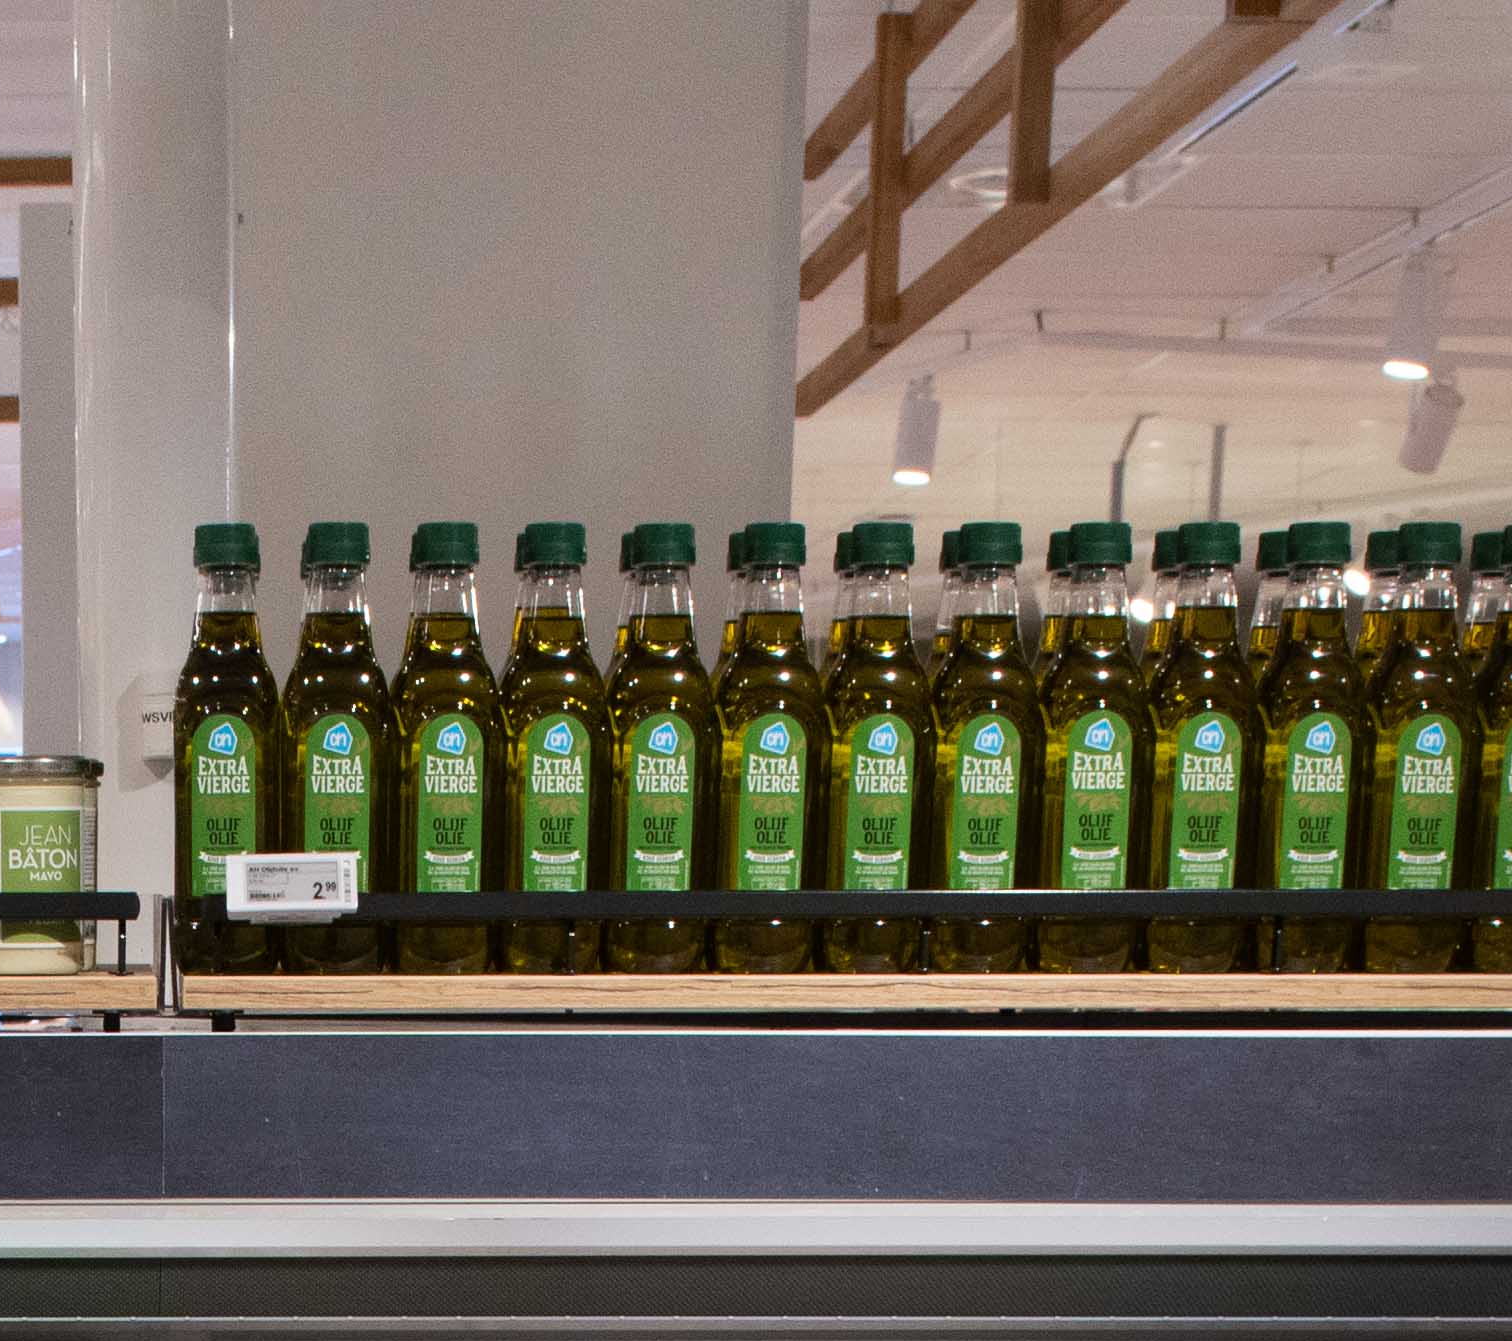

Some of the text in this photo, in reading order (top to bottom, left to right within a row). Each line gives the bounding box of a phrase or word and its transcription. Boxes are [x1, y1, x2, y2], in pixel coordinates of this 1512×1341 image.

[198, 756, 248, 776] EXTRA
[1399, 755, 1452, 775] EXTRA
[197, 776, 250, 794] VIERGE
[1399, 774, 1455, 794] VIERGE
[209, 832, 239, 846] OLIE
[1409, 830, 1440, 846] OLIE
